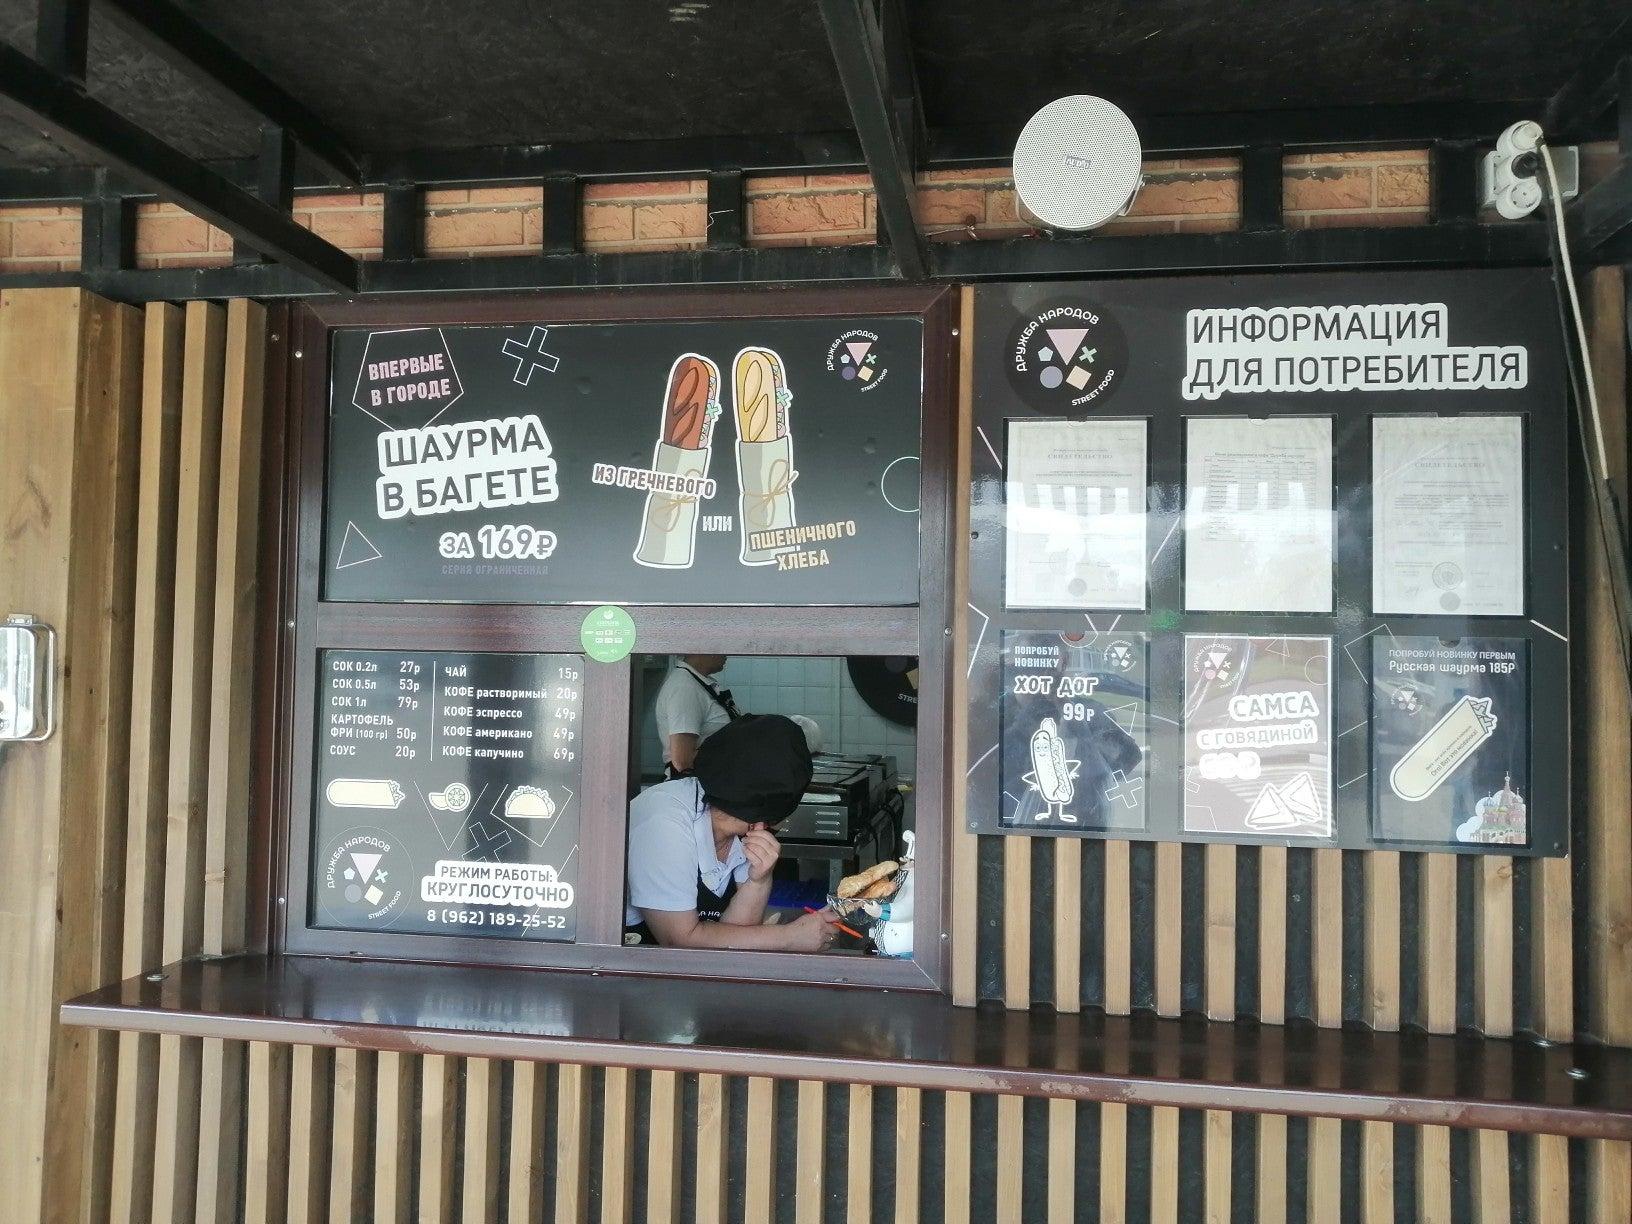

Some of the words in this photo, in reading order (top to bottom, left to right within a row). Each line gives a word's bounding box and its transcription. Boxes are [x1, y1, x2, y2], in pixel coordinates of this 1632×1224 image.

[1193, 310, 1442, 346] ИНФОРМАЦИЯ
[1015, 321, 1039, 372] ДРУЖБА
[1038, 307, 1099, 325] НАРОДОВ
[826, 338, 842, 371] ДРУЖБА
[840, 329, 879, 341] НАРОДОВ
[368, 353, 444, 381] ВПЕРВЫЕ
[1189, 358, 1263, 393] ДЛЯ
[1275, 352, 1521, 388] ПОТРЕБИТЕЛЯ
[370, 389, 382, 407] В
[386, 378, 451, 405] ГОРОДЕ
[1071, 388, 1100, 406] STREET
[1098, 369, 1115, 391] FOOD
[383, 421, 545, 468] ШАУРМА
[382, 481, 405, 513] В
[416, 465, 552, 508] БАГЕТЕ
[594, 464, 615, 483] ИЗ
[618, 468, 715, 498] ГРЕЧНЕВОГО
[702, 516, 733, 532] ИЛИ
[442, 535, 472, 555] ЗА
[750, 520, 857, 551] ПШЕНИЧНОГО
[441, 564, 472, 575] СЕРИЯ
[475, 564, 549, 576] ОГРАНИЧЕННАЯ
[776, 549, 830, 571] ХЛЕБА
[1014, 645, 1059, 656] ПОПРОБУЙ
[1389, 649, 1435, 659] ПОПРОБУЙ
[1437, 650, 1478, 660] НОВИНКУ
[1479, 651, 1516, 661] ПЕРВЫМ
[333, 661, 353, 672] СОК
[356, 661, 378, 672] 0.2л
[400, 661, 421, 675] 27р
[1014, 657, 1060, 668] НОВИНКУ
[1389, 660, 1436, 674] Русская
[1439, 663, 1486, 675] шаурма
[445, 665, 467, 677] ЧАЙ
[558, 667, 578, 681] 15р
[332, 679, 353, 689] СОК
[355, 679, 377, 690] 0.5л
[399, 679, 420, 692] 53р
[444, 686, 474, 698] КОФЕ
[476, 688, 548, 700] растворимый
[556, 688, 577, 701] 20р
[1015, 676, 1053, 694] ХОТ
[1058, 677, 1098, 697] ДОГ
[331, 697, 352, 707] СОК
[355, 697, 367, 707] 1л
[398, 696, 418, 710] 79р
[1232, 694, 1316, 718] САМСА
[330, 715, 394, 726] КАРТОФЕЛЬ
[443, 706, 473, 717] КОФЕ
[475, 708, 523, 720] эспрессо
[555, 708, 576, 721] 49р
[330, 727, 353, 739] ФРИ
[396, 728, 417, 741] 50р
[443, 726, 473, 737] КОФЕ
[474, 728, 533, 740] американо
[553, 727, 575, 741] 49р
[1201, 733, 1211, 746] С
[1215, 722, 1314, 745] ГОВЯДИНОЙ
[330, 745, 356, 756] СОУС
[395, 746, 416, 759] 20р
[442, 746, 472, 757] КОФЕ
[474, 748, 524, 760] капучино
[553, 747, 575, 761] 69р
[326, 846, 346, 889] ДРУЖБА
[344, 836, 391, 852] НАРОДОВ
[440, 865, 490, 880] РЕЖИМ
[494, 868, 554, 883] РАБОТЫ:
[427, 881, 570, 902] КРУГЛОСУТОЧНО
[367, 905, 390, 920] STREET
[388, 890, 402, 908] FOOD
[426, 909, 437, 922] 8
[441, 909, 484, 926] (962)
[489, 912, 567, 929] 189-25-52
